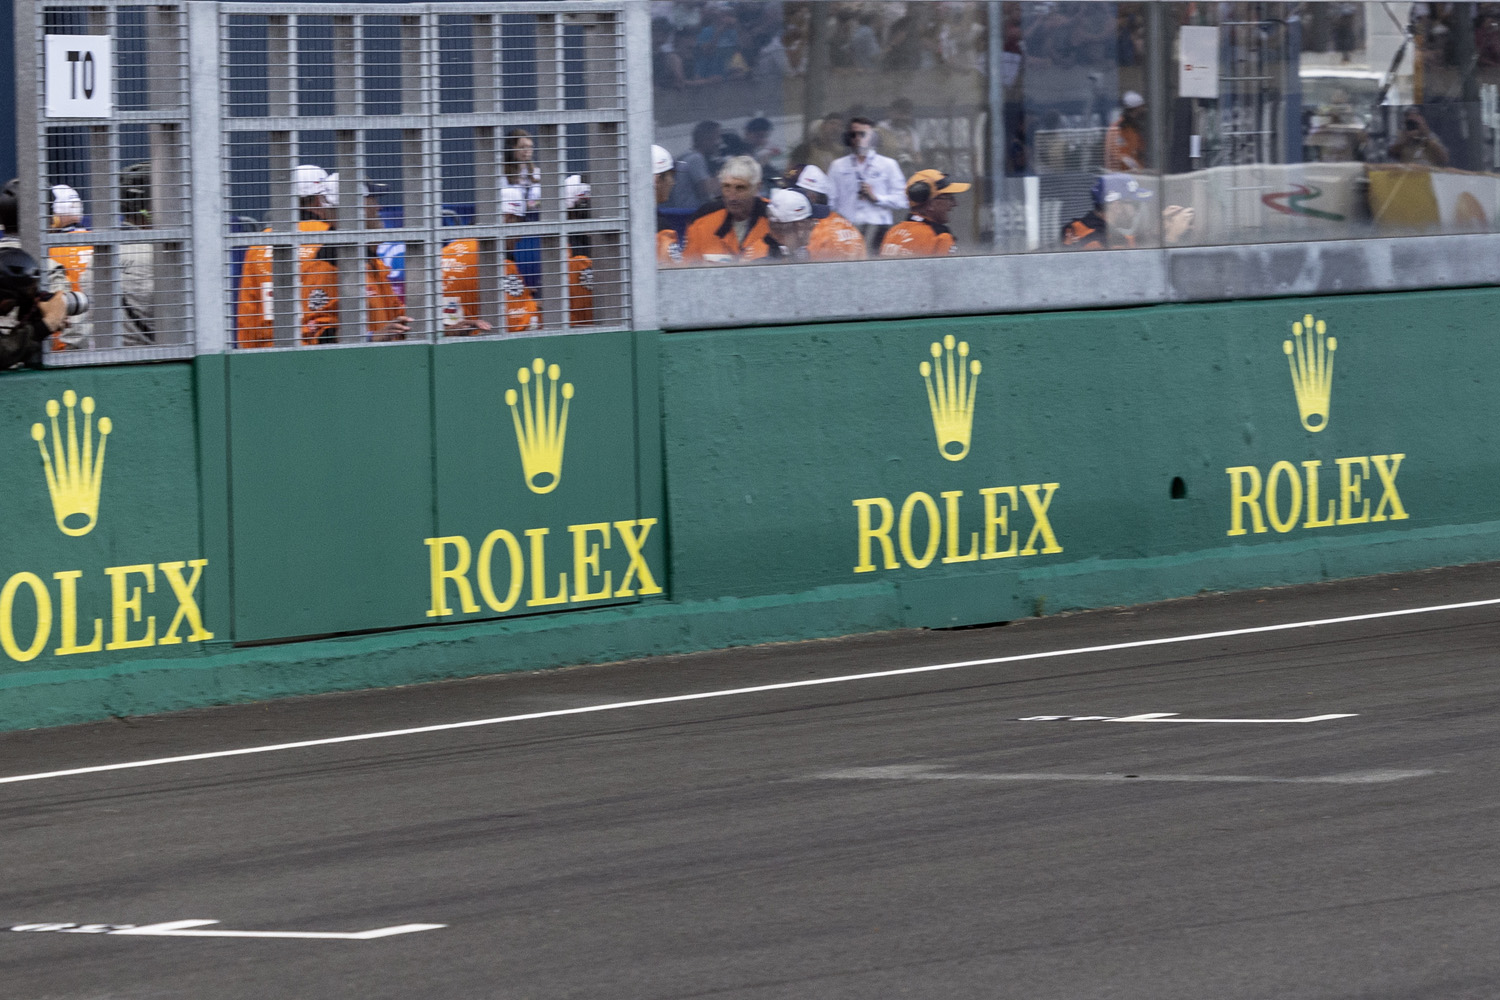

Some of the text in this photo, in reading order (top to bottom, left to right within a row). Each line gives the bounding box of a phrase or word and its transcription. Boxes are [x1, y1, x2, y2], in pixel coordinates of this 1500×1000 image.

[853, 482, 1063, 573] ROLEX
[1226, 453, 1409, 536] ROLEX
[0, 558, 214, 662] OLEX
[424, 517, 663, 618] ROLEX
